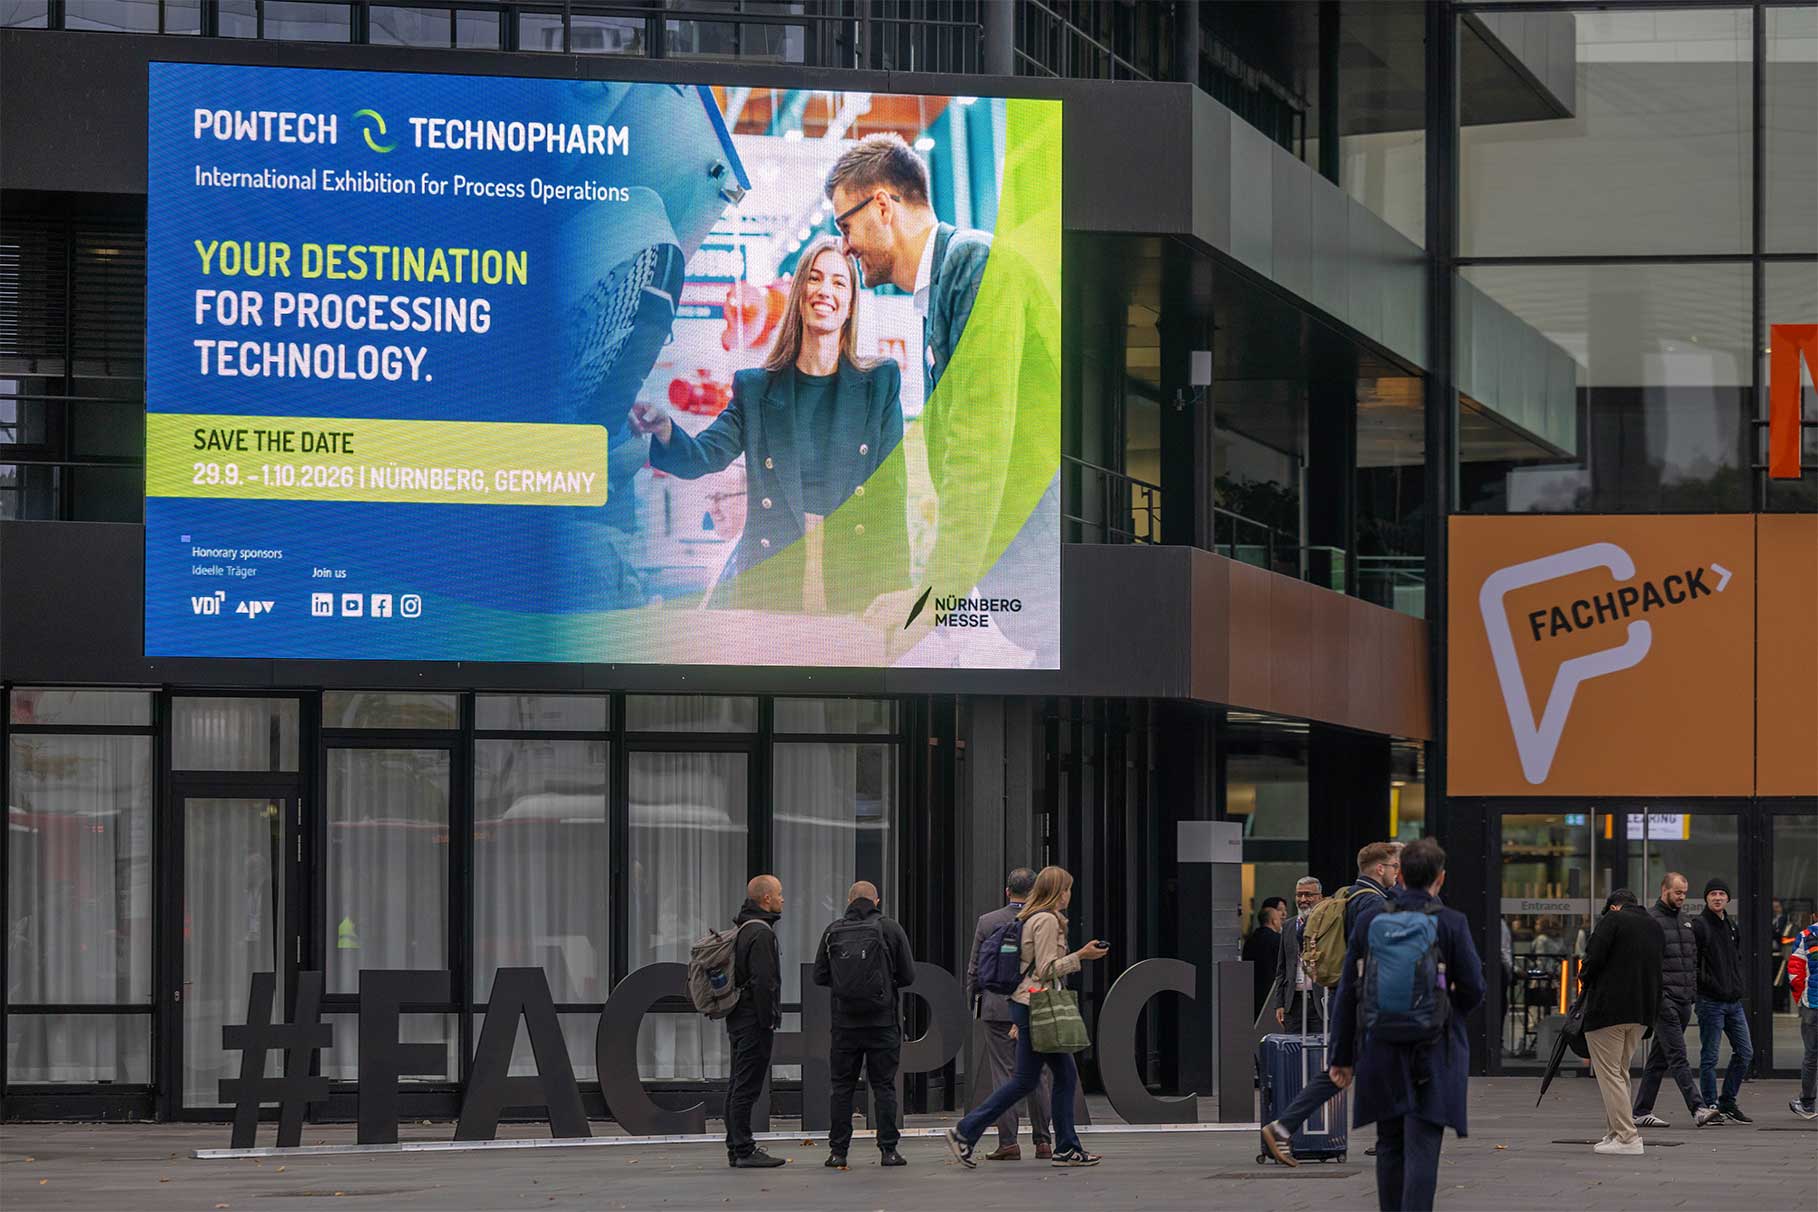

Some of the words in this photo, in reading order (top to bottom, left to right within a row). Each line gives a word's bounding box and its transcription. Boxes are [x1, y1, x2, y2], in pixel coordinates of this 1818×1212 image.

[194, 108, 337, 144] POWTECH
[408, 117, 629, 156] TECHNOPHARM
[195, 165, 316, 190] International
[322, 169, 416, 194] Exhibition
[421, 172, 449, 195] for
[454, 175, 525, 199] Process
[530, 178, 630, 204] Operations
[194, 240, 291, 278] YOUR
[301, 242, 528, 285] DESTINATION
[195, 290, 263, 326] FOR
[273, 292, 491, 334] PROCESSING
[193, 340, 433, 382] TECHNOLOGY.
[193, 428, 248, 451] SAVE
[253, 430, 295, 452] THE
[301, 431, 354, 454] DATE
[370, 462, 489, 493] NÜRNBERG,
[494, 470, 596, 493] GERMANY
[192, 546, 237, 560] Honorary
[239, 549, 283, 560] sponsors
[192, 565, 224, 576] Ideelle
[226, 565, 257, 579] Träger
[312, 567, 333, 579] Join
[335, 569, 347, 579] us
[935, 595, 1022, 612] NÜRNBERG
[1527, 566, 1712, 641] FACHPACK
[935, 614, 989, 627] MESSE
[1521, 901, 1570, 911] Entrance
